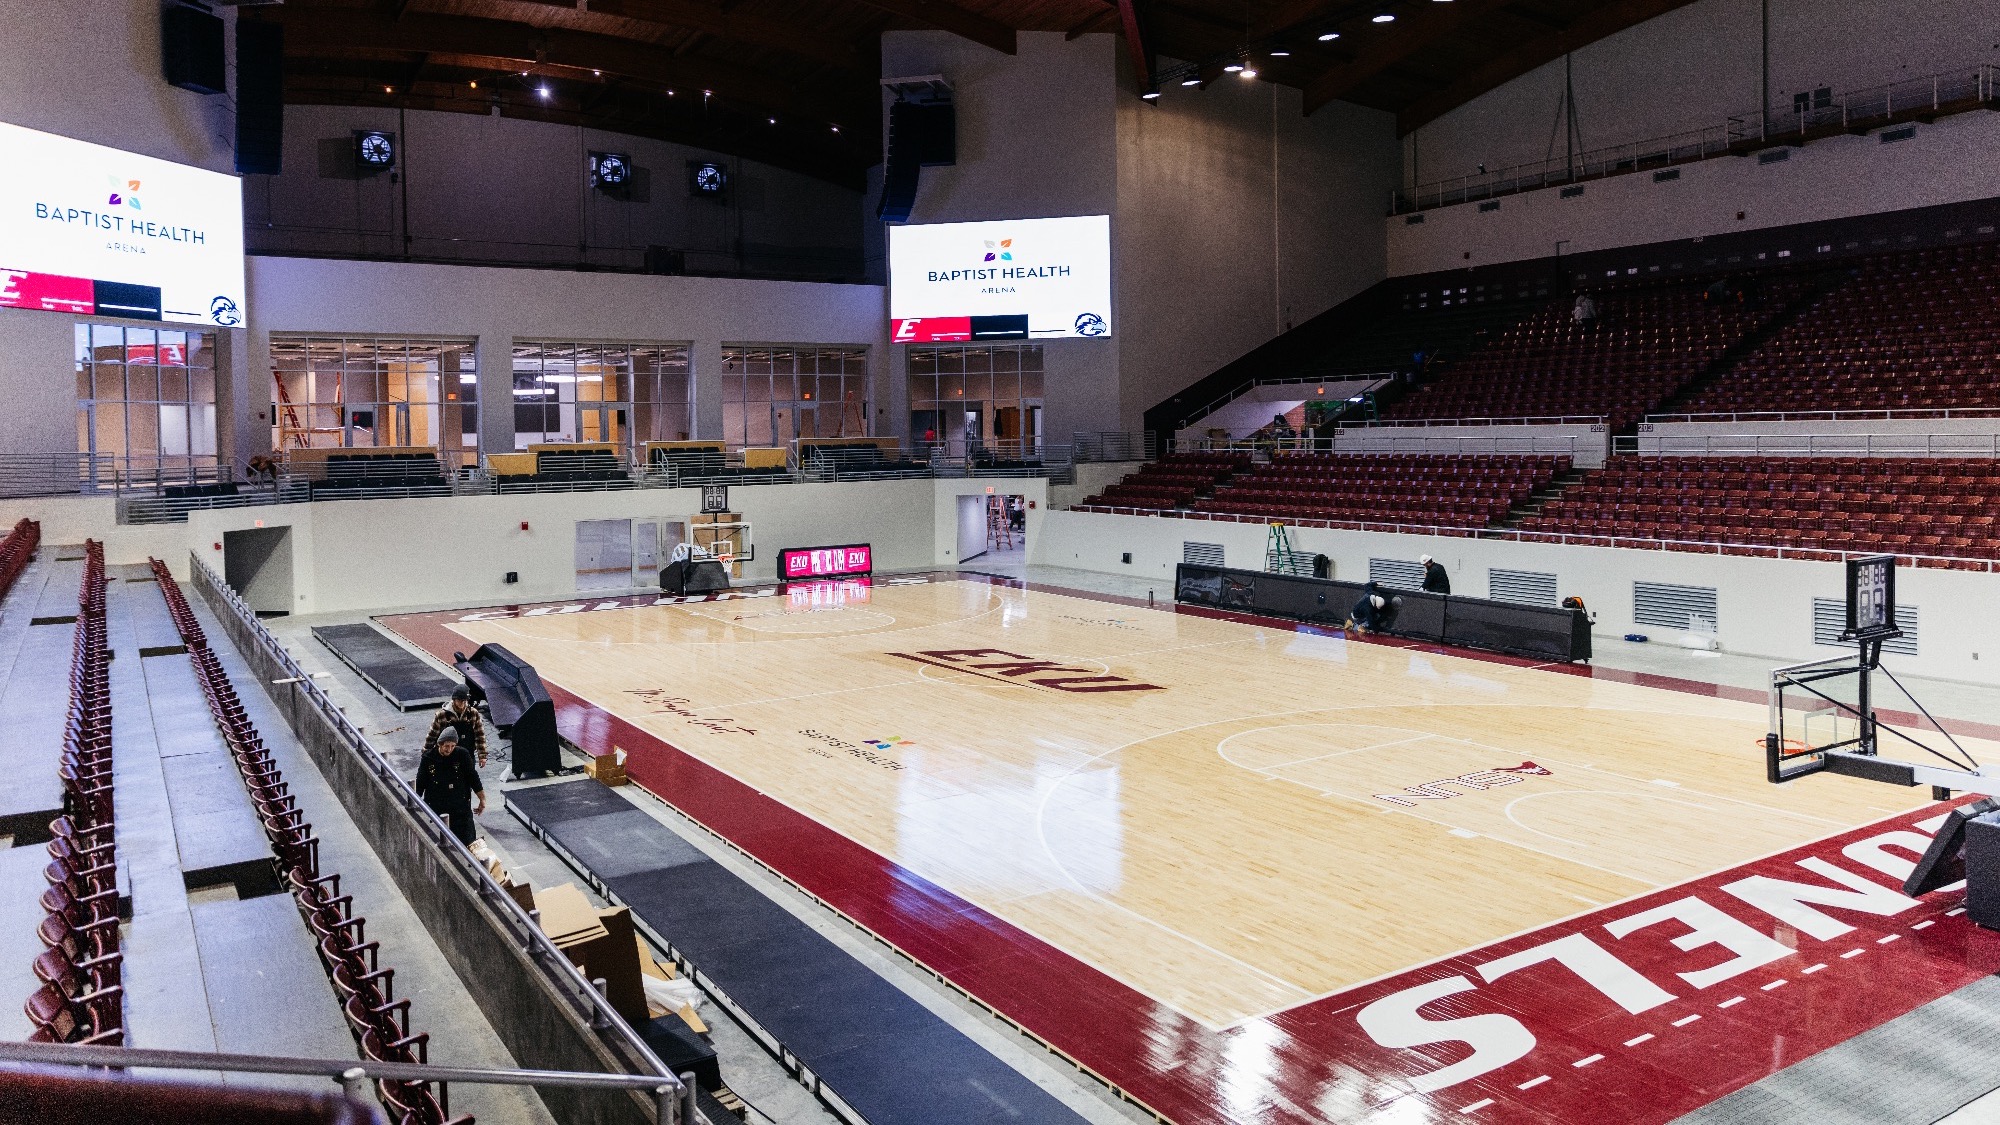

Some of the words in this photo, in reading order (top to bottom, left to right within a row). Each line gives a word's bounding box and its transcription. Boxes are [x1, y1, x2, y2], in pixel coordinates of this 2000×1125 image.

[35, 202, 124, 231] BAPTIST
[131, 219, 205, 245] HEALTH
[106, 242, 146, 254] ARENA
[928, 268, 998, 282] BAPTIST
[1002, 265, 1071, 279] HEALTH
[896, 319, 921, 338] E
[848, 551, 866, 565] EKU
[915, 648, 1168, 693] EKU
[1356, 812, 1967, 1095] ONELS
